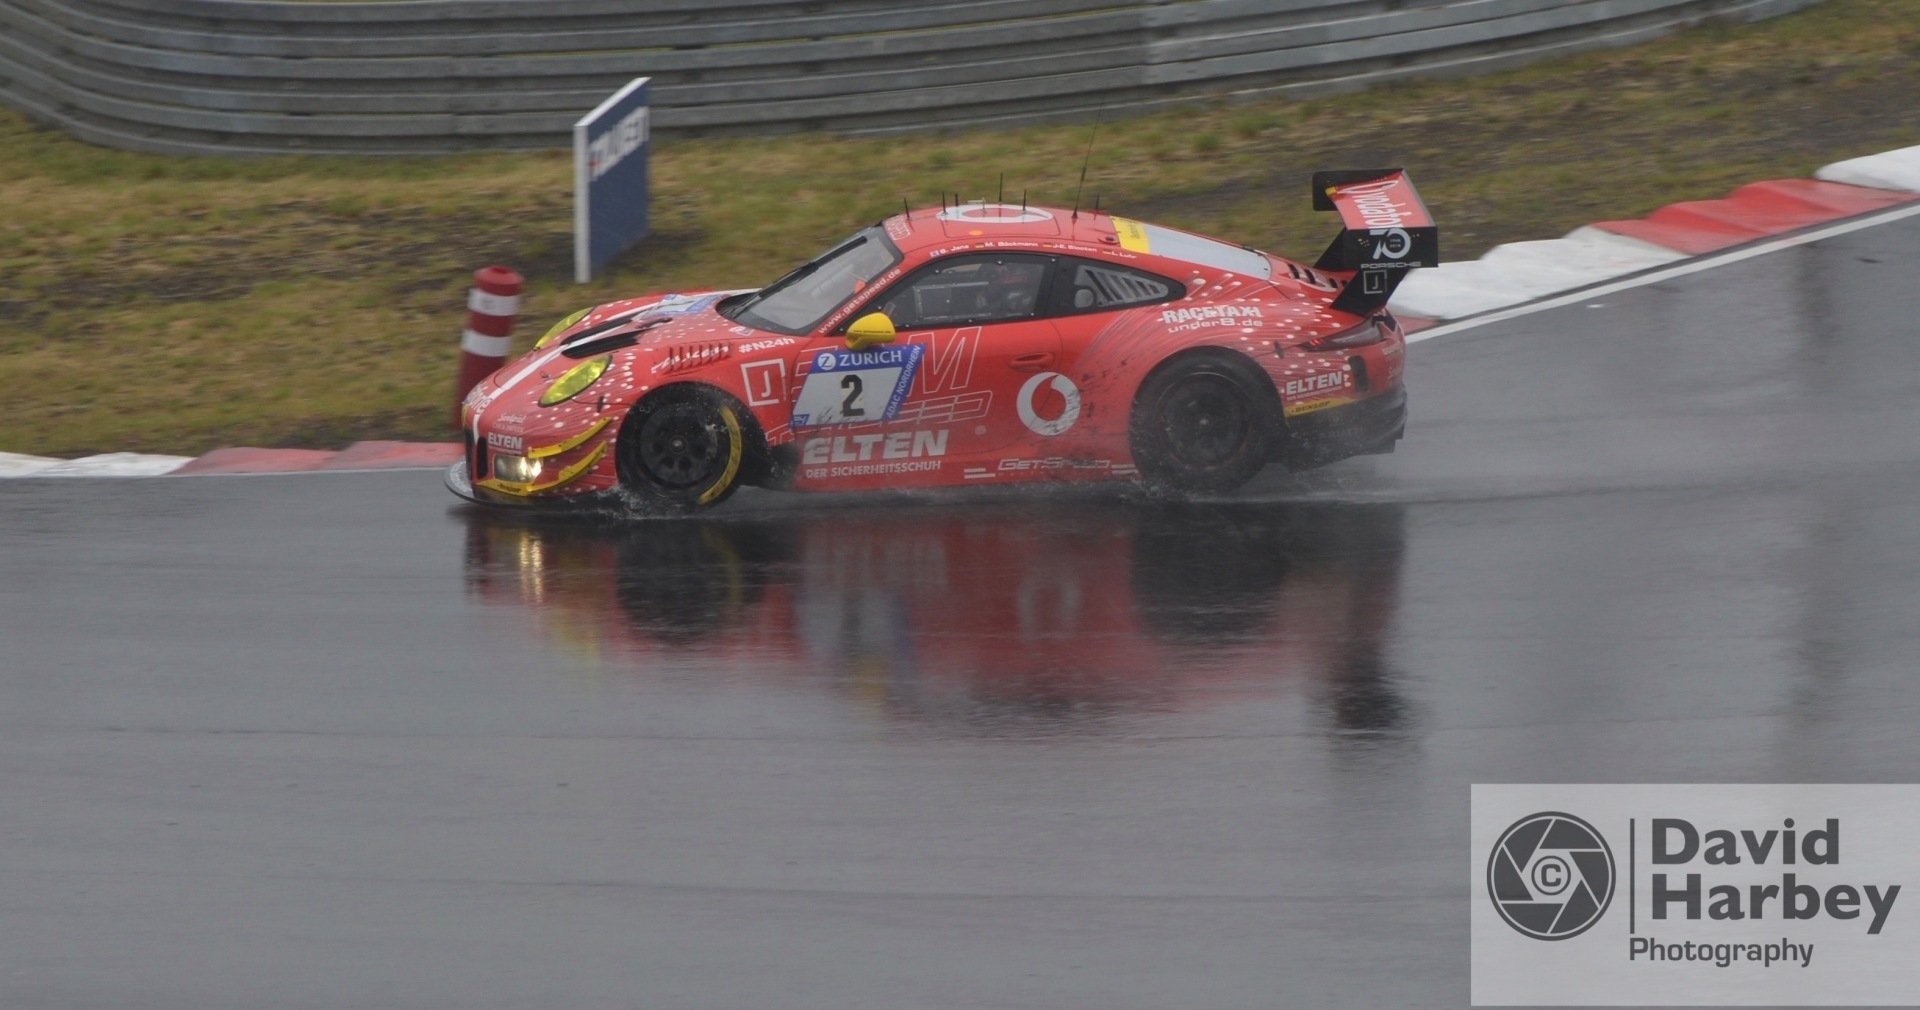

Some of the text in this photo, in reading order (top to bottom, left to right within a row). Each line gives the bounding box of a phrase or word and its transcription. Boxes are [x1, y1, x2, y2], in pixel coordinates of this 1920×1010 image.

[1369, 228, 1411, 259] 70
[1361, 261, 1422, 269] PORSCHE
[818, 267, 901, 334] www.getspeed.de
[1168, 318, 1263, 333] under8.de
[738, 337, 795, 353] #N24h
[839, 350, 902, 367] ZURICH
[760, 371, 771, 398] J
[885, 345, 921, 419] ADAC NORDRHEIN
[1286, 371, 1342, 396] ELTEN
[841, 374, 865, 418] 2
[488, 432, 523, 450] ELTEN
[803, 430, 949, 465] ELTEN
[806, 460, 941, 479] DER SICHERHEITSSCHUH
